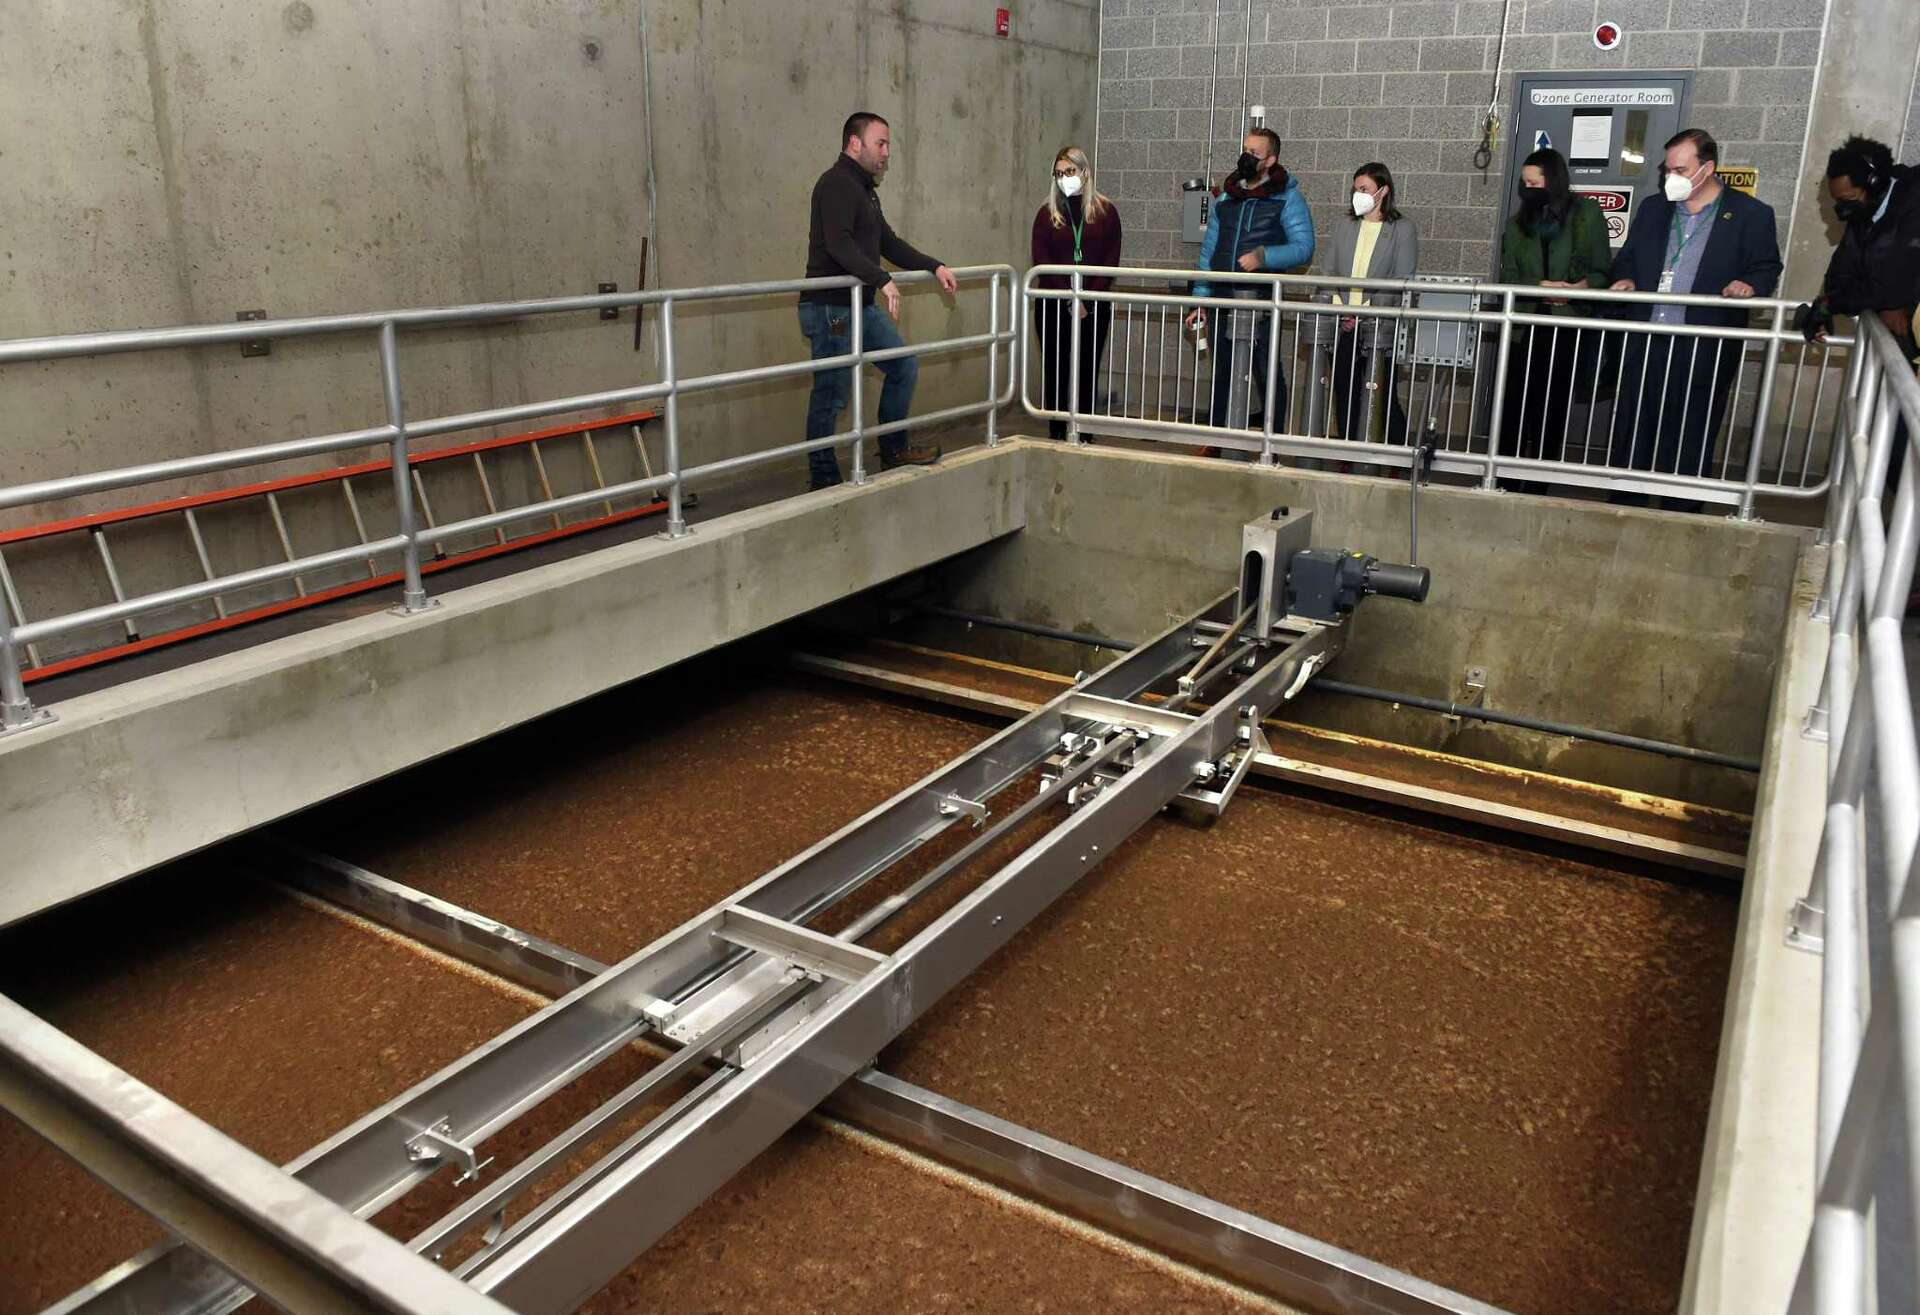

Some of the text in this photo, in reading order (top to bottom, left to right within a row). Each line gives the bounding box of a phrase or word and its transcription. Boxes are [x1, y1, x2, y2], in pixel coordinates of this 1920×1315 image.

[1532, 92, 1673, 103] Ozone Generator Room
[1720, 173, 1754, 185] TION
